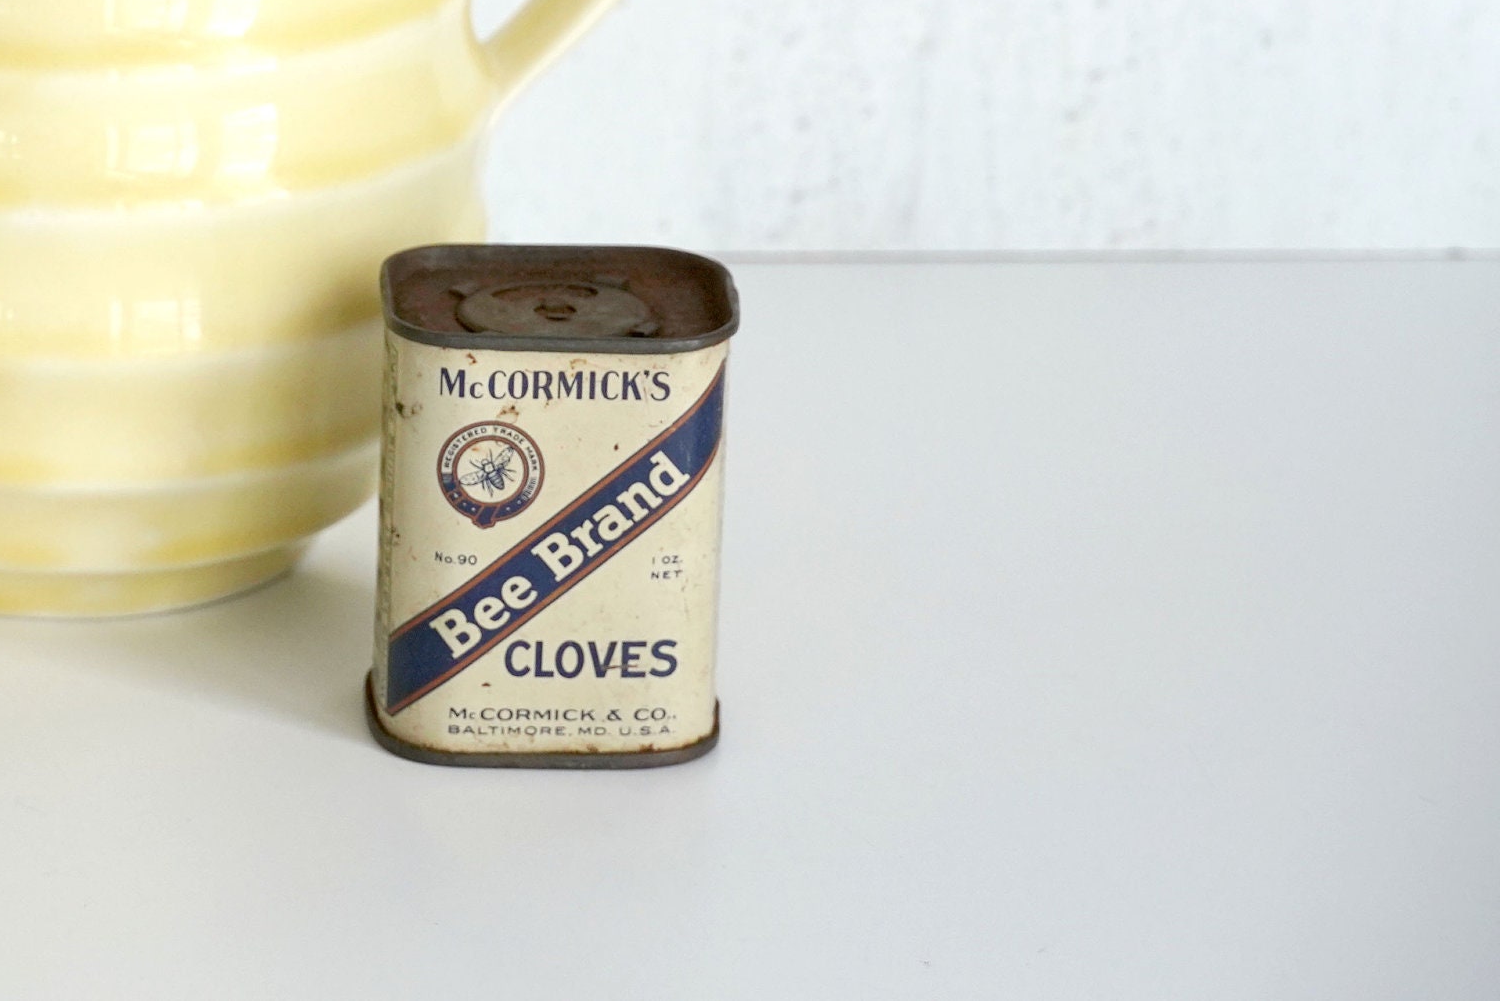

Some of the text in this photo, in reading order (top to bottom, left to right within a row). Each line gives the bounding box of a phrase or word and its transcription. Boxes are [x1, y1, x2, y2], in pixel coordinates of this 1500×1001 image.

[439, 367, 672, 402] McCORMICK'S
[443, 426, 539, 473] REGISTERED TRADE MARK
[429, 450, 690, 659] Bee Brand
[650, 569, 683, 579] NET
[504, 639, 678, 679] CLOVES
[449, 706, 596, 722] McCORMICK
[606, 709, 623, 721] &
